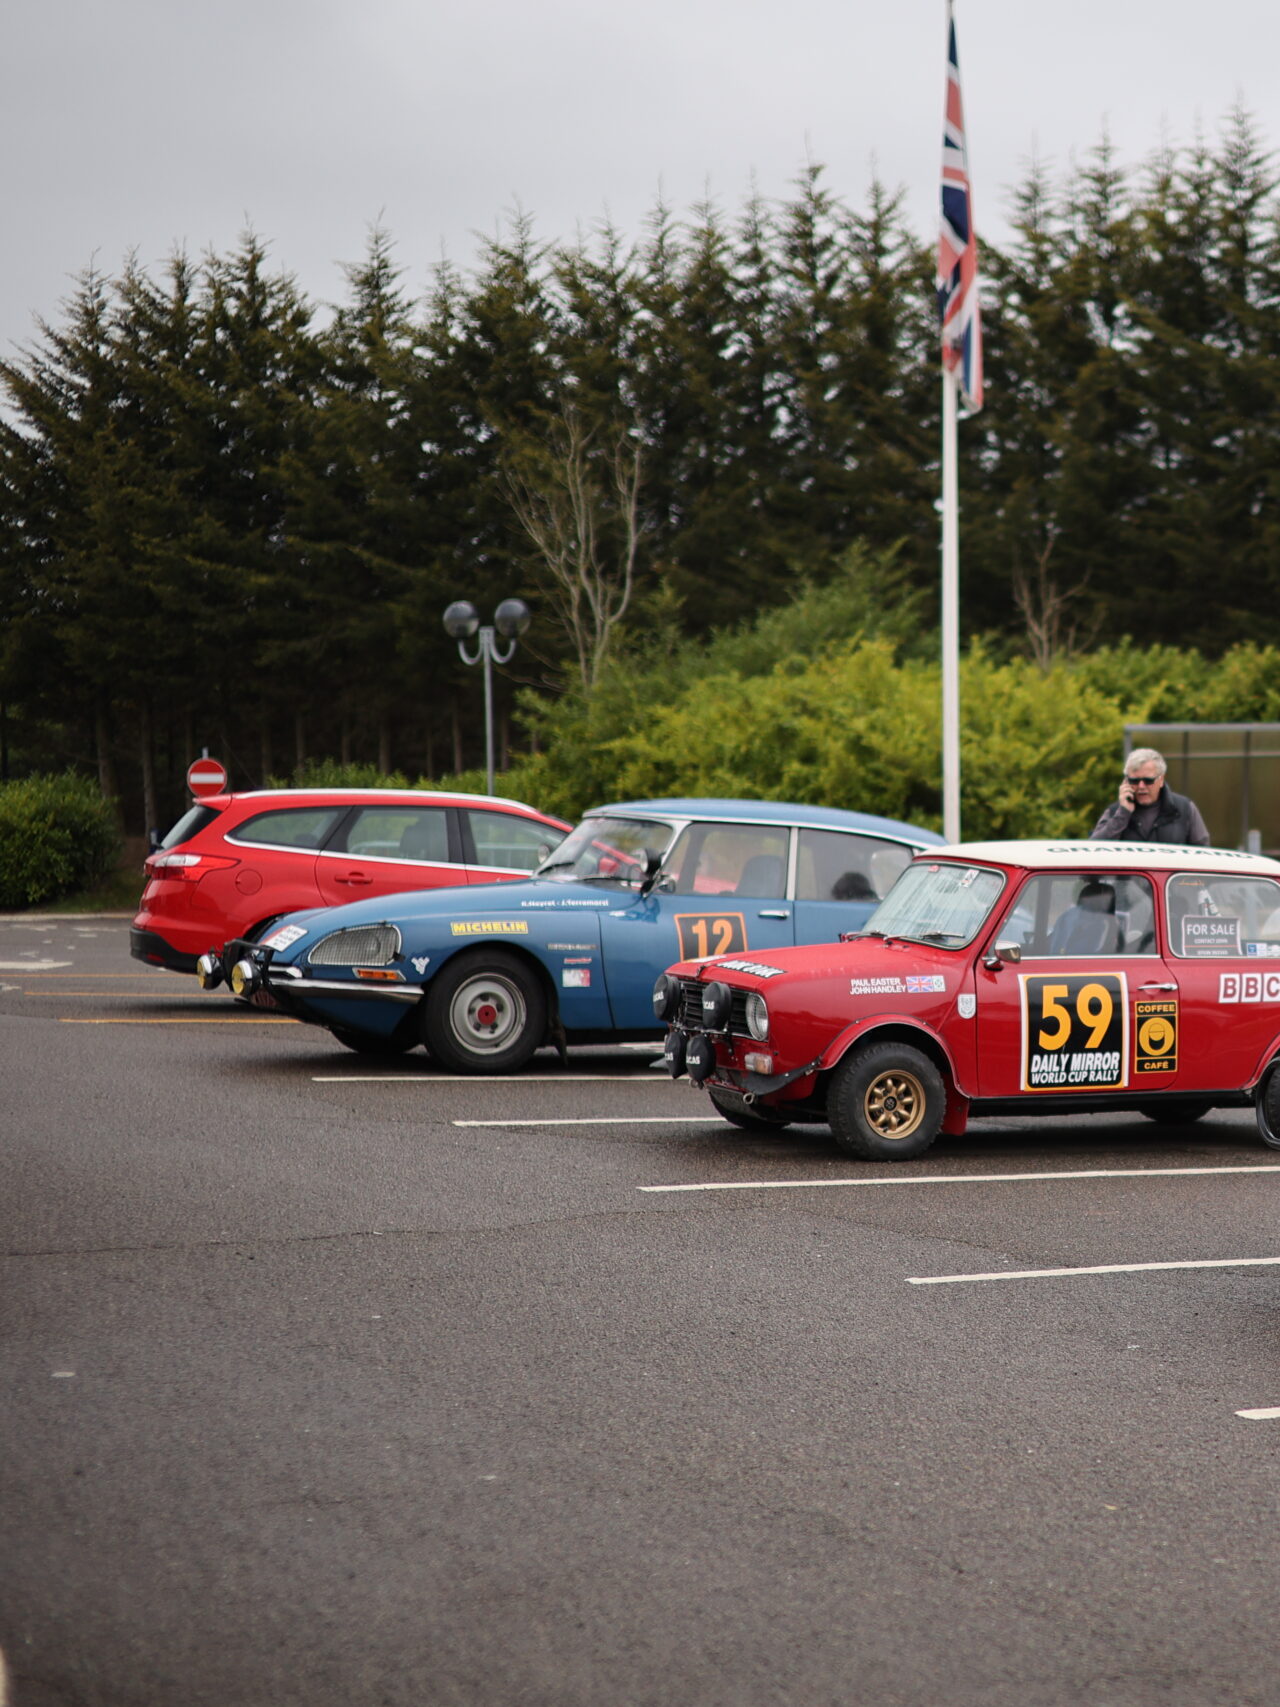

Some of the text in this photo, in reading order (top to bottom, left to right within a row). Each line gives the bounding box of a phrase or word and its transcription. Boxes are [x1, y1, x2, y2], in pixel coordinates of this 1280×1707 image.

[1046, 847, 1254, 859] GRANDSTAND
[453, 922, 527, 933] MICHELIN
[1187, 924, 1236, 936] FOR SALE
[691, 919, 733, 958] 12
[851, 977, 902, 988] PAUL EASTER
[849, 985, 906, 995] JOHN HANDLEY
[1137, 1004, 1176, 1013] COFFEE
[1038, 983, 1113, 1051] 59
[1031, 1052, 1121, 1073] DAILY MIRROR
[1143, 1060, 1170, 1070] CAFÉ
[1031, 1069, 1120, 1084] WORLD CUP RALLY
